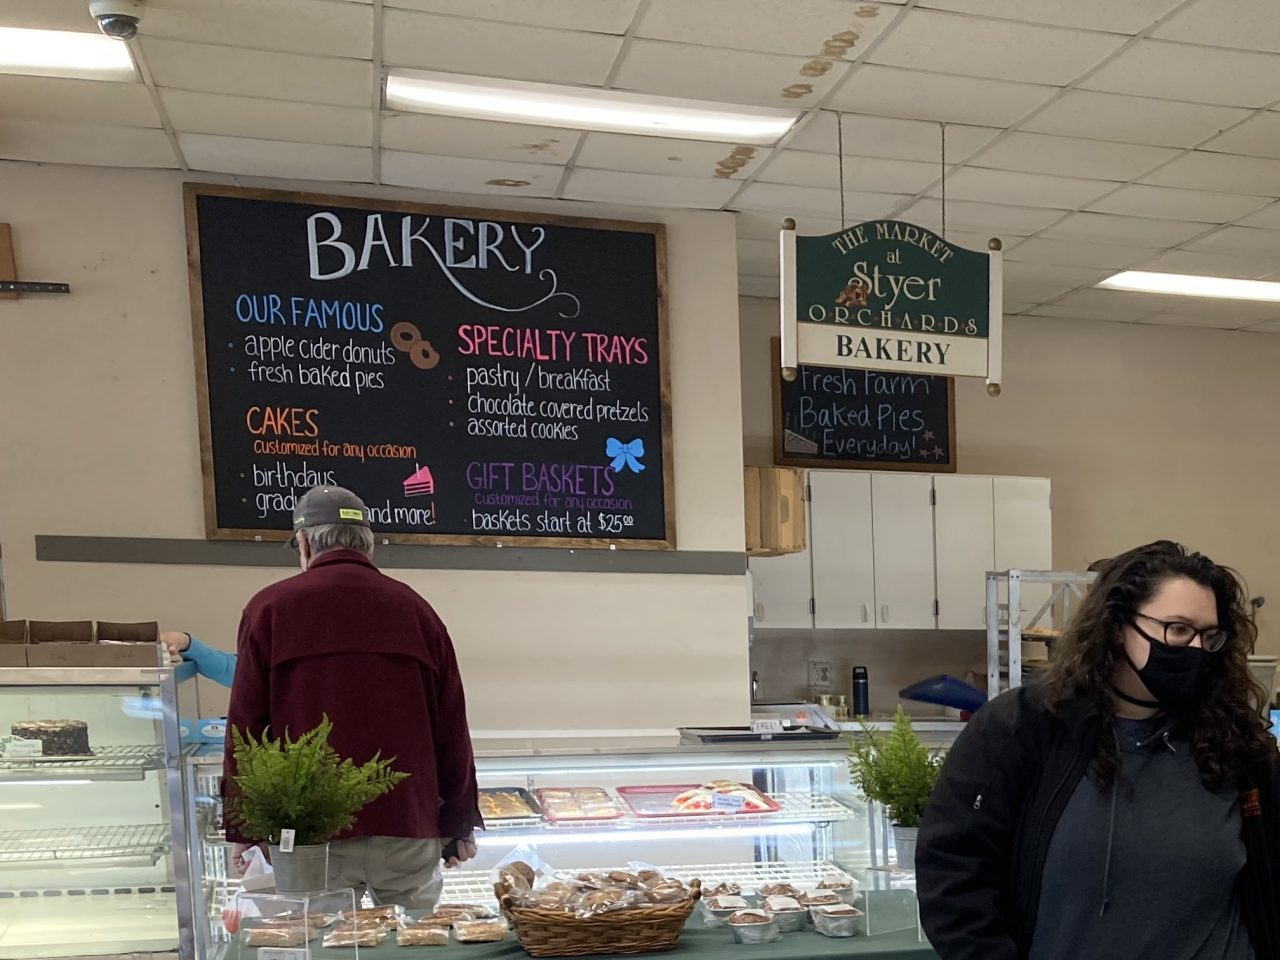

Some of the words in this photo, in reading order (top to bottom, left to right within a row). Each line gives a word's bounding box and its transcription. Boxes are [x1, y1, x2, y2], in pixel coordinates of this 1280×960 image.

[306, 212, 570, 300] BAKERY
[832, 226, 868, 255] THE
[875, 222, 954, 263] MARKET
[886, 249, 902, 264] at
[848, 261, 941, 310] Styer
[236, 294, 286, 325] OUR
[291, 297, 384, 333] FAMOUS
[808, 304, 978, 335] ORCHARDS
[244, 335, 294, 361] apple
[299, 337, 340, 360] cider
[342, 338, 396, 365] donuts
[458, 324, 577, 361] SPECIALTY
[582, 332, 648, 364] TRAYS
[836, 333, 951, 365] BAKERY
[248, 361, 293, 383] fresh
[299, 363, 350, 387] baked
[355, 370, 384, 395] pies
[466, 363, 519, 396] pastry
[538, 365, 612, 391] breakfast
[801, 365, 857, 396] Fresh
[865, 369, 930, 396] Farm
[246, 406, 319, 437] CAKES
[467, 392, 537, 416] chocolate
[540, 397, 593, 420] covered
[597, 399, 649, 422] pretzels
[799, 396, 872, 429] Baked
[877, 403, 926, 431] Pies
[467, 416, 527, 437] assorted
[531, 421, 579, 440] cookies
[254, 440, 319, 456] customized
[322, 440, 341, 456] for
[343, 442, 365, 463] any
[367, 444, 417, 459] occasion
[823, 429, 917, 460] Everyday!
[466, 461, 515, 490] GIFT
[521, 462, 615, 496] BASKETS
[256, 487, 301, 519] grad
[365, 499, 392, 523] and
[394, 502, 436, 525] more!
[474, 492, 539, 507] customized
[544, 493, 560, 508] for
[565, 496, 586, 511] any
[586, 496, 632, 510] occasion
[471, 509, 531, 531] baskets
[537, 510, 571, 532] start
[577, 511, 593, 533] at
